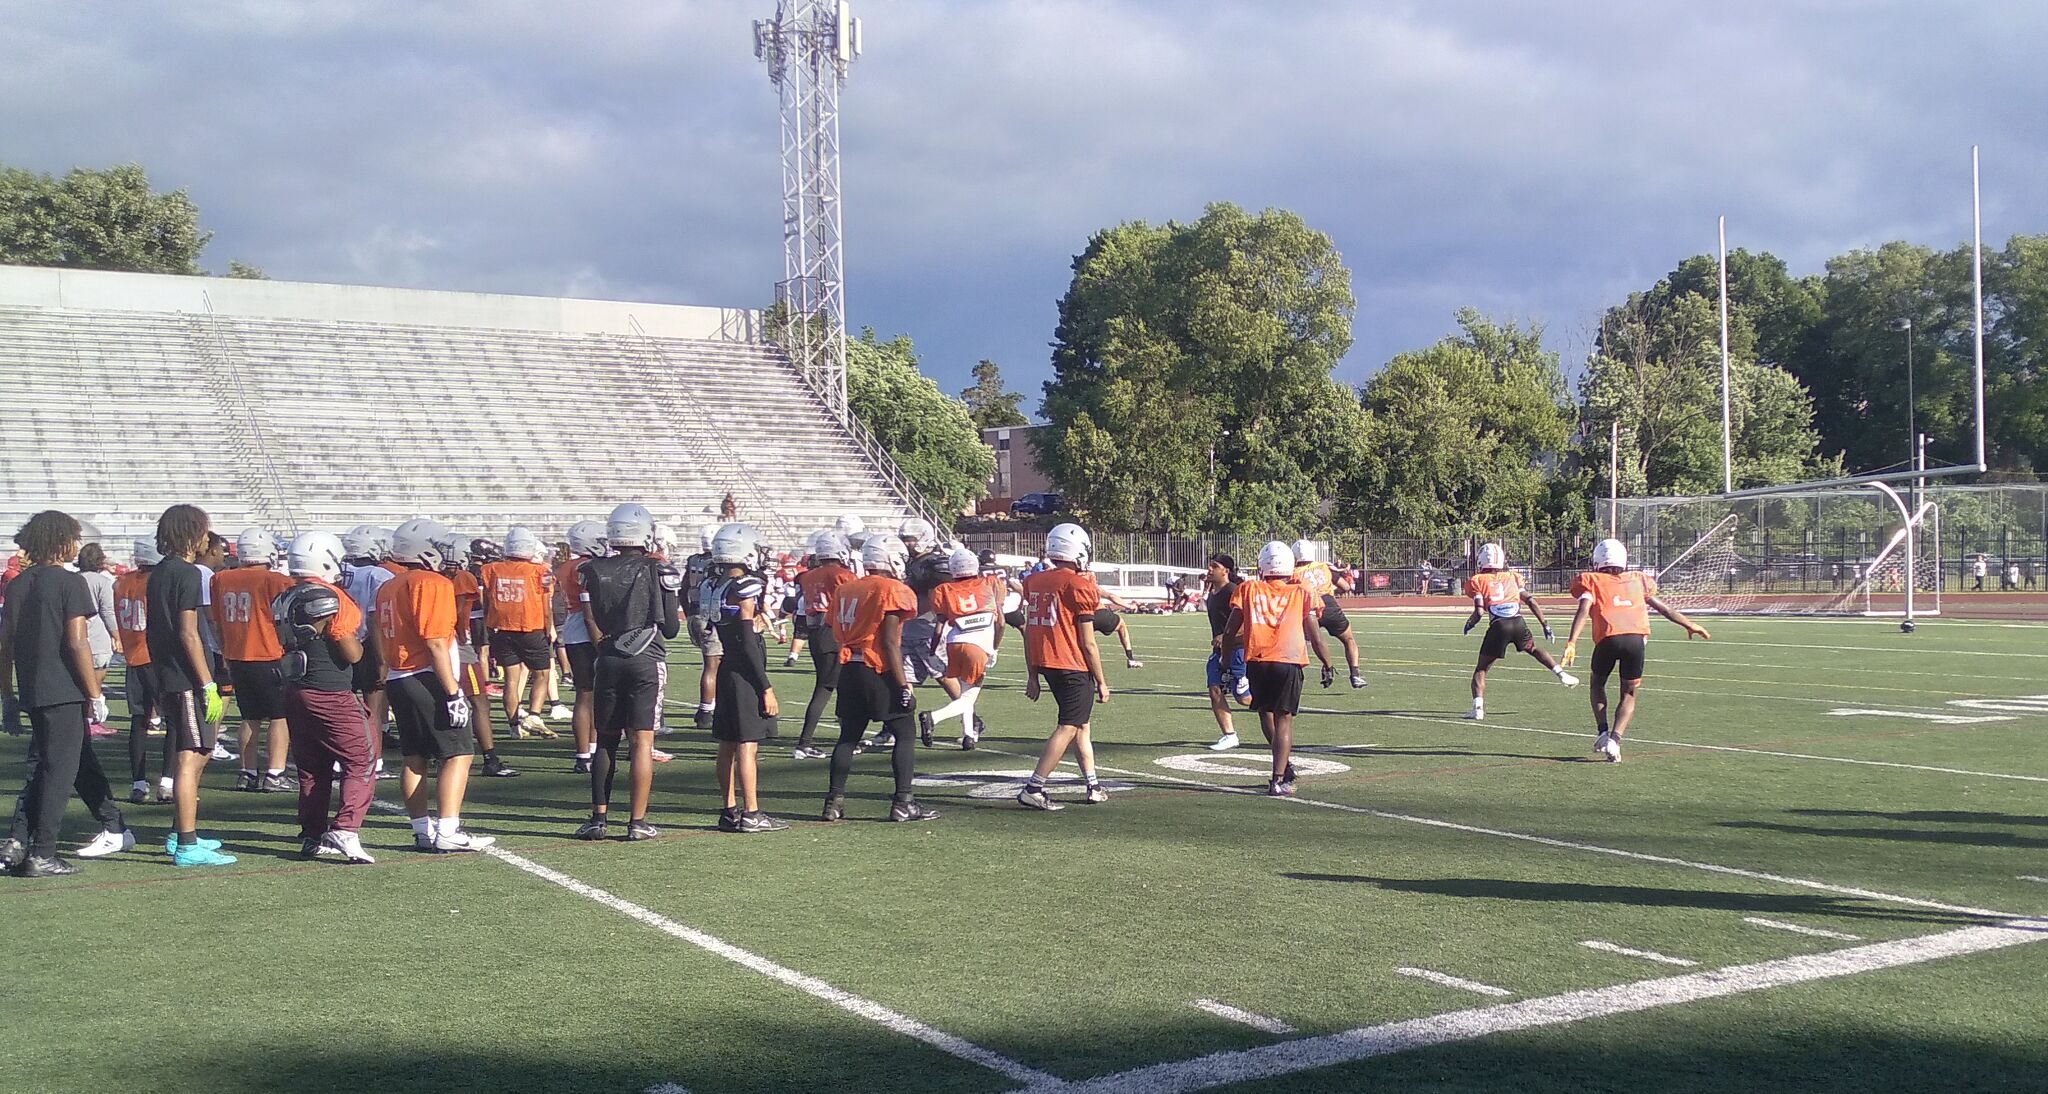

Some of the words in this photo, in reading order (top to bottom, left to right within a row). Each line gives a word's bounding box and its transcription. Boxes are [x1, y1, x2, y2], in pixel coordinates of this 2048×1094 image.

[497, 577, 525, 603] 55
[119, 598, 147, 632] 20
[224, 591, 251, 623] 89
